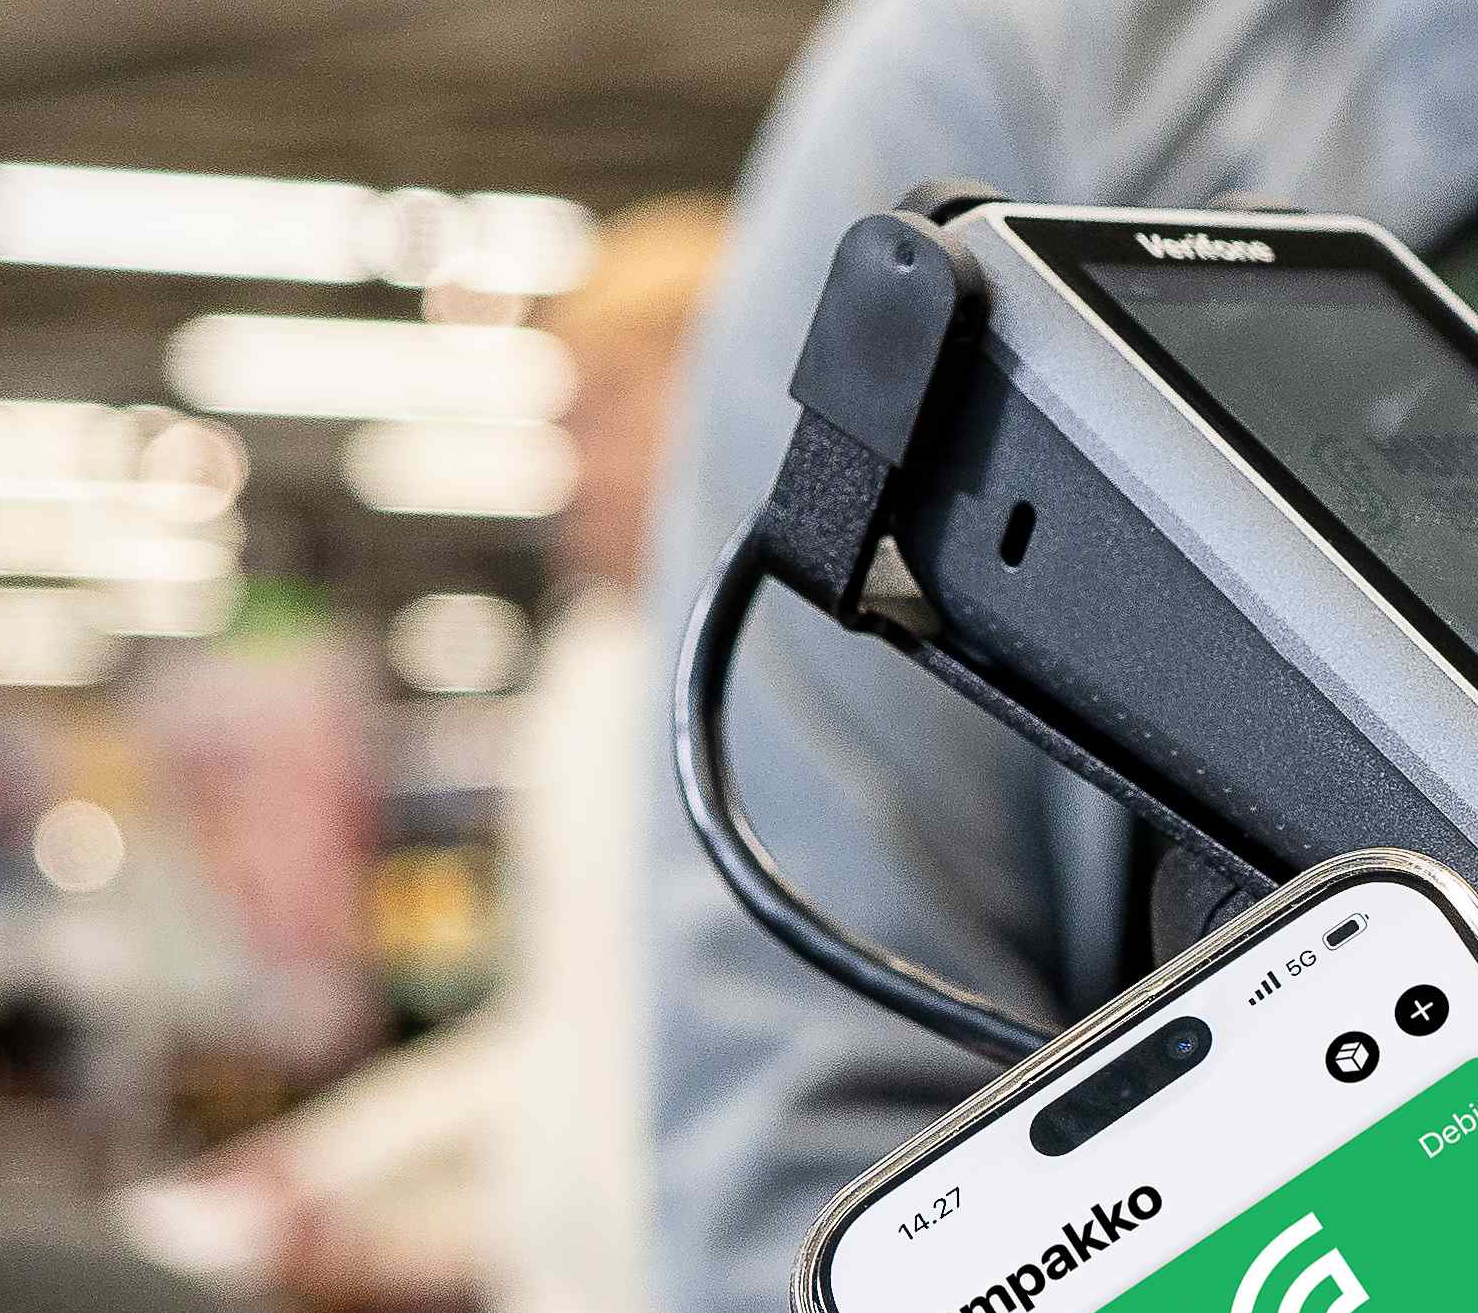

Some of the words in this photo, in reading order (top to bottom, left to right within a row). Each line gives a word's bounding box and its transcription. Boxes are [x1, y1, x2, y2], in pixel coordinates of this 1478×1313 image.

[1135, 232, 1276, 263] Verifone
[1285, 950, 1317, 977] 5G
[898, 1186, 960, 1240] 14.27
